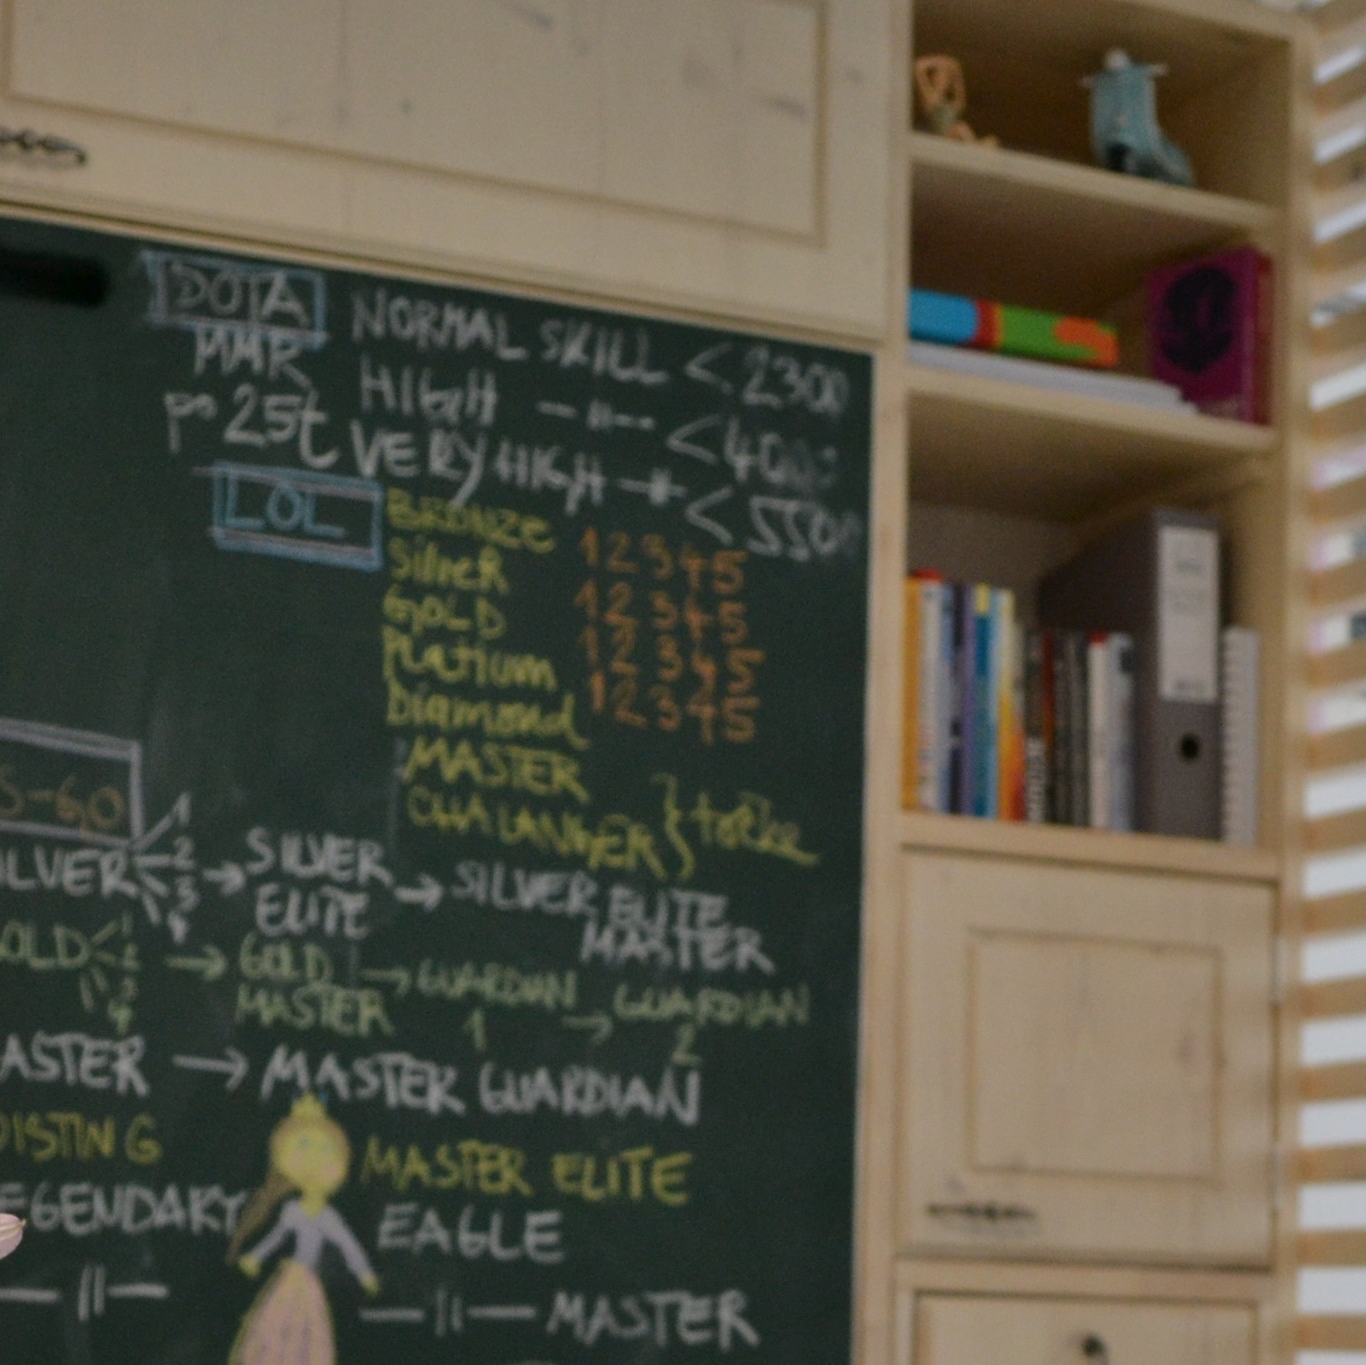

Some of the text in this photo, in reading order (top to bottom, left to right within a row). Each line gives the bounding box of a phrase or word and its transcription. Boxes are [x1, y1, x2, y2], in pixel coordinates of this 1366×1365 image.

[351, 289, 528, 361] NORMAL
[540, 316, 671, 386] SKILL
[360, 352, 499, 427] HIGH
[349, 418, 488, 507] VERY
[223, 477, 348, 540] LOL
[245, 826, 394, 887] SILVER
[450, 860, 599, 918] SILVER
[259, 1043, 465, 1116] MASTER
[360, 1137, 531, 1196] MASTER
[551, 1146, 695, 1203] ELITE
[376, 1203, 568, 1264] EAGLE
[546, 1288, 761, 1350] MASTER
